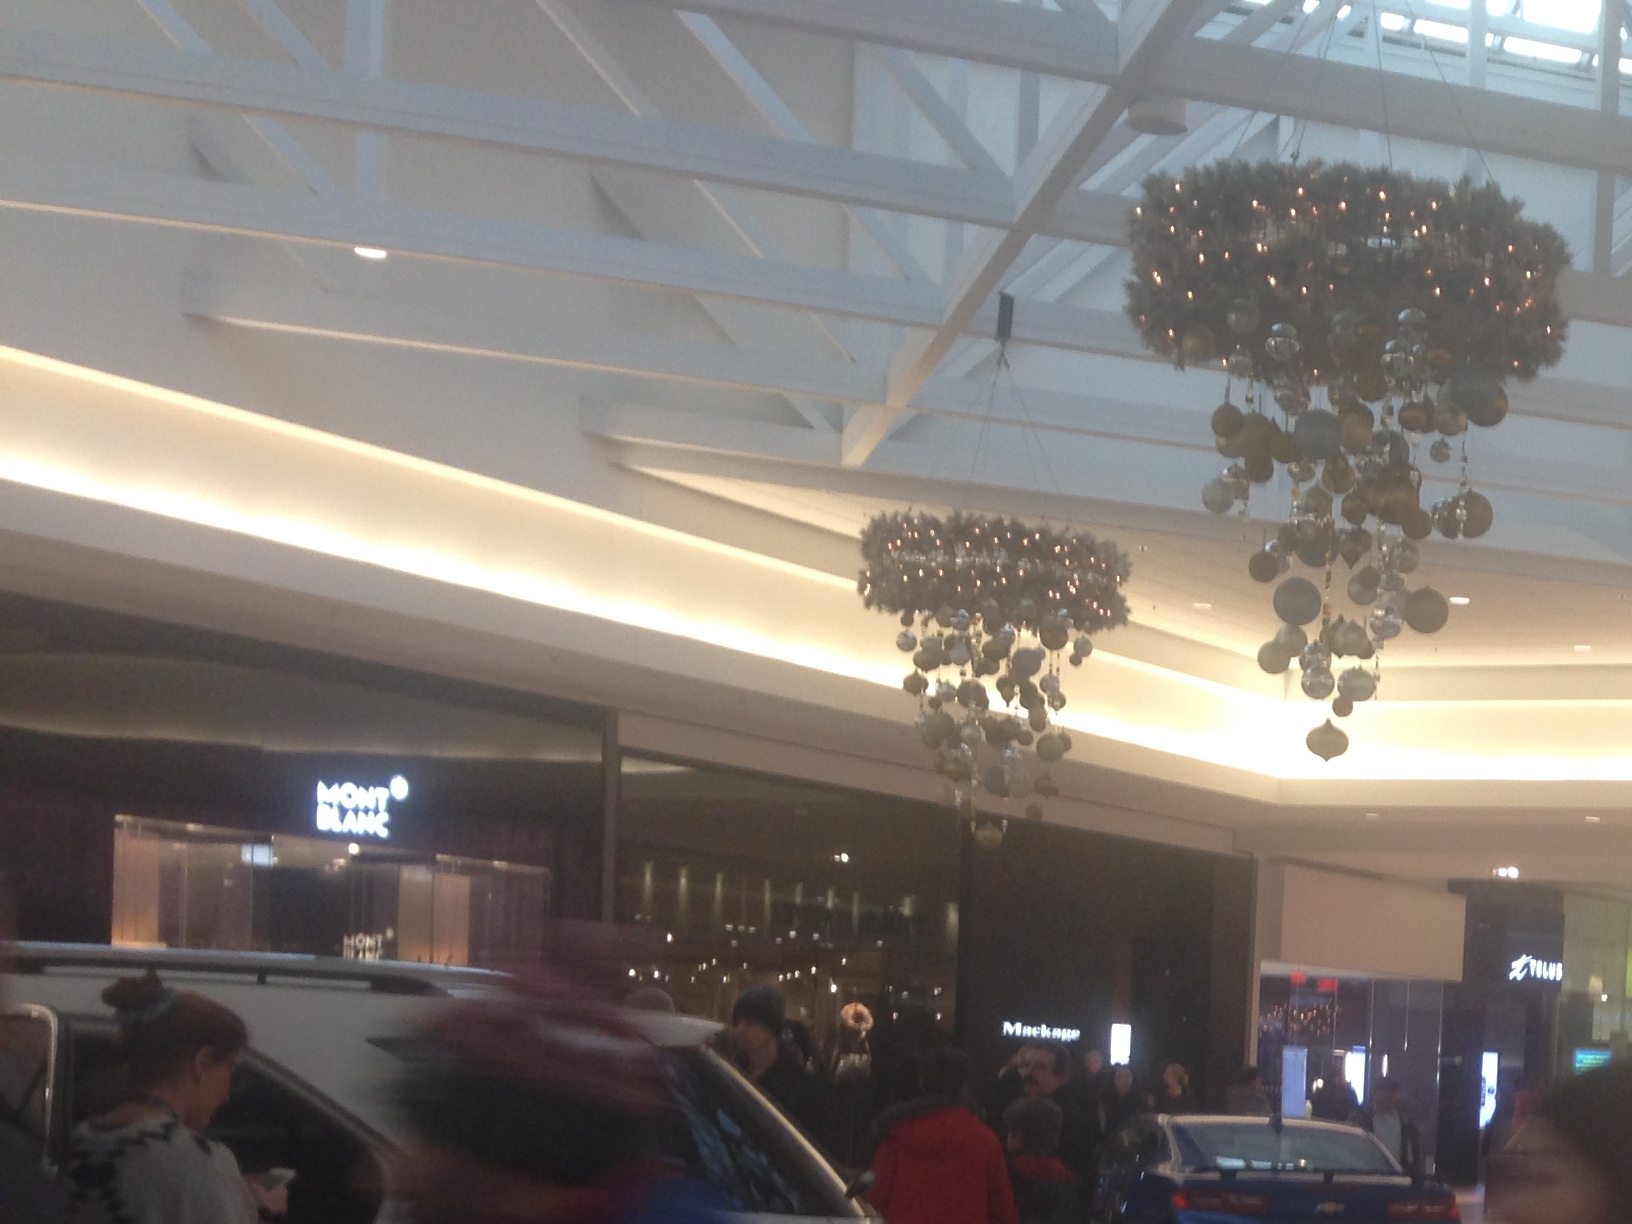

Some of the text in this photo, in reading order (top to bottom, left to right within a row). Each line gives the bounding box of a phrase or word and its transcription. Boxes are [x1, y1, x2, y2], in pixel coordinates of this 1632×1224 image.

[316, 780, 390, 812] MONT
[316, 804, 390, 838] BLANC
[1002, 1021, 1081, 1042] Mackage
